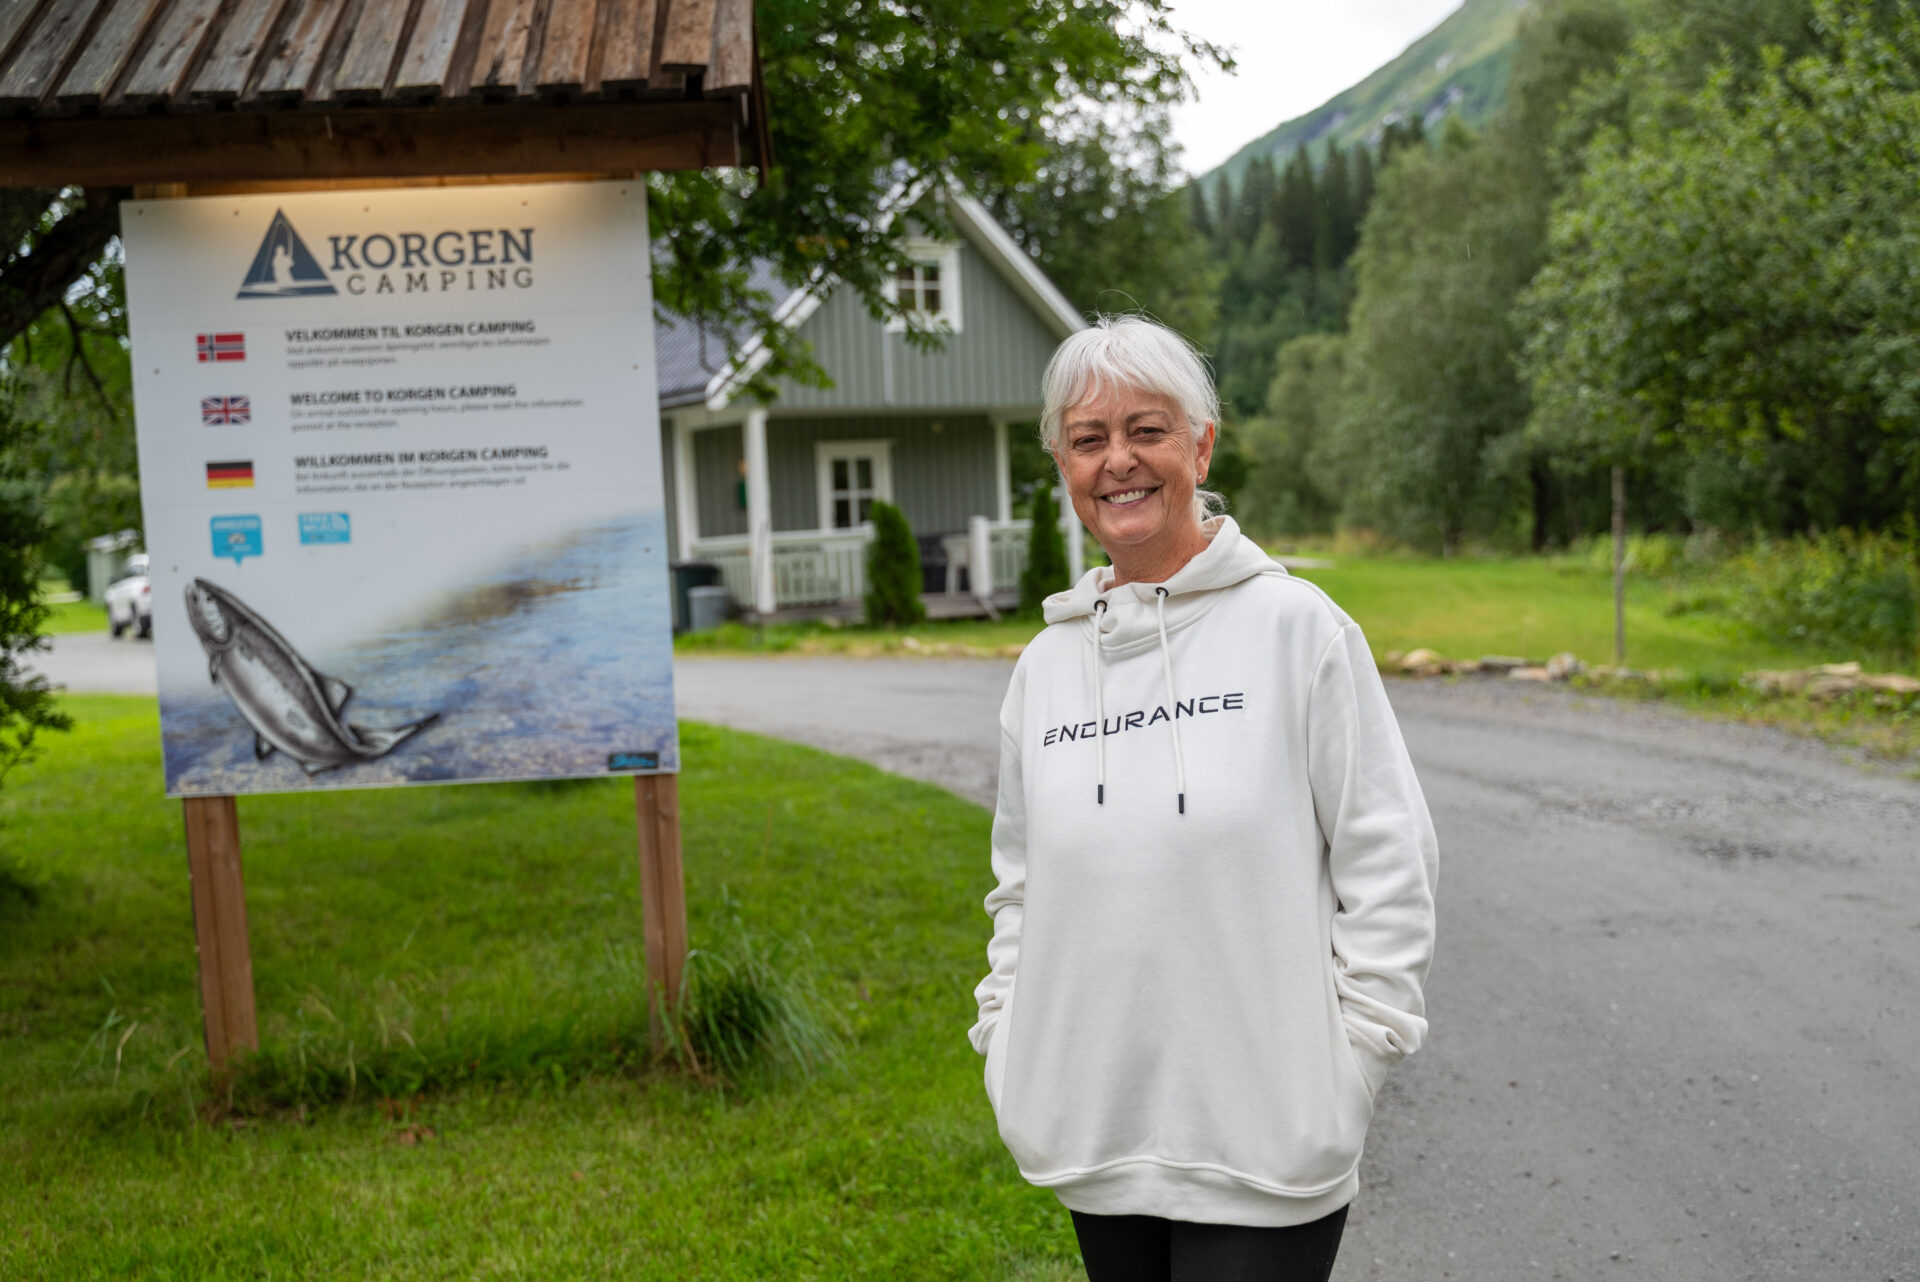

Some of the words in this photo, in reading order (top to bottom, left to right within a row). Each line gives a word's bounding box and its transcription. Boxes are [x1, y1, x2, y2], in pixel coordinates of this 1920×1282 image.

[328, 227, 535, 271] KORGEN
[346, 266, 534, 295] CAMPING
[285, 327, 378, 342] VELKOMMEN
[381, 325, 401, 338] TIL
[405, 323, 464, 338] KORGEN
[467, 320, 535, 335] CAMPING
[290, 391, 360, 406] WELCOME
[364, 389, 383, 403] TO
[386, 386, 446, 402] KORGEN
[449, 383, 517, 399] CAMPING
[295, 452, 394, 468] WILLKOMMEN
[398, 450, 415, 464] IM
[419, 447, 478, 463] KORGEN
[481, 445, 547, 461] CAMPING
[1044, 692, 1244, 747] ENDURANCE
